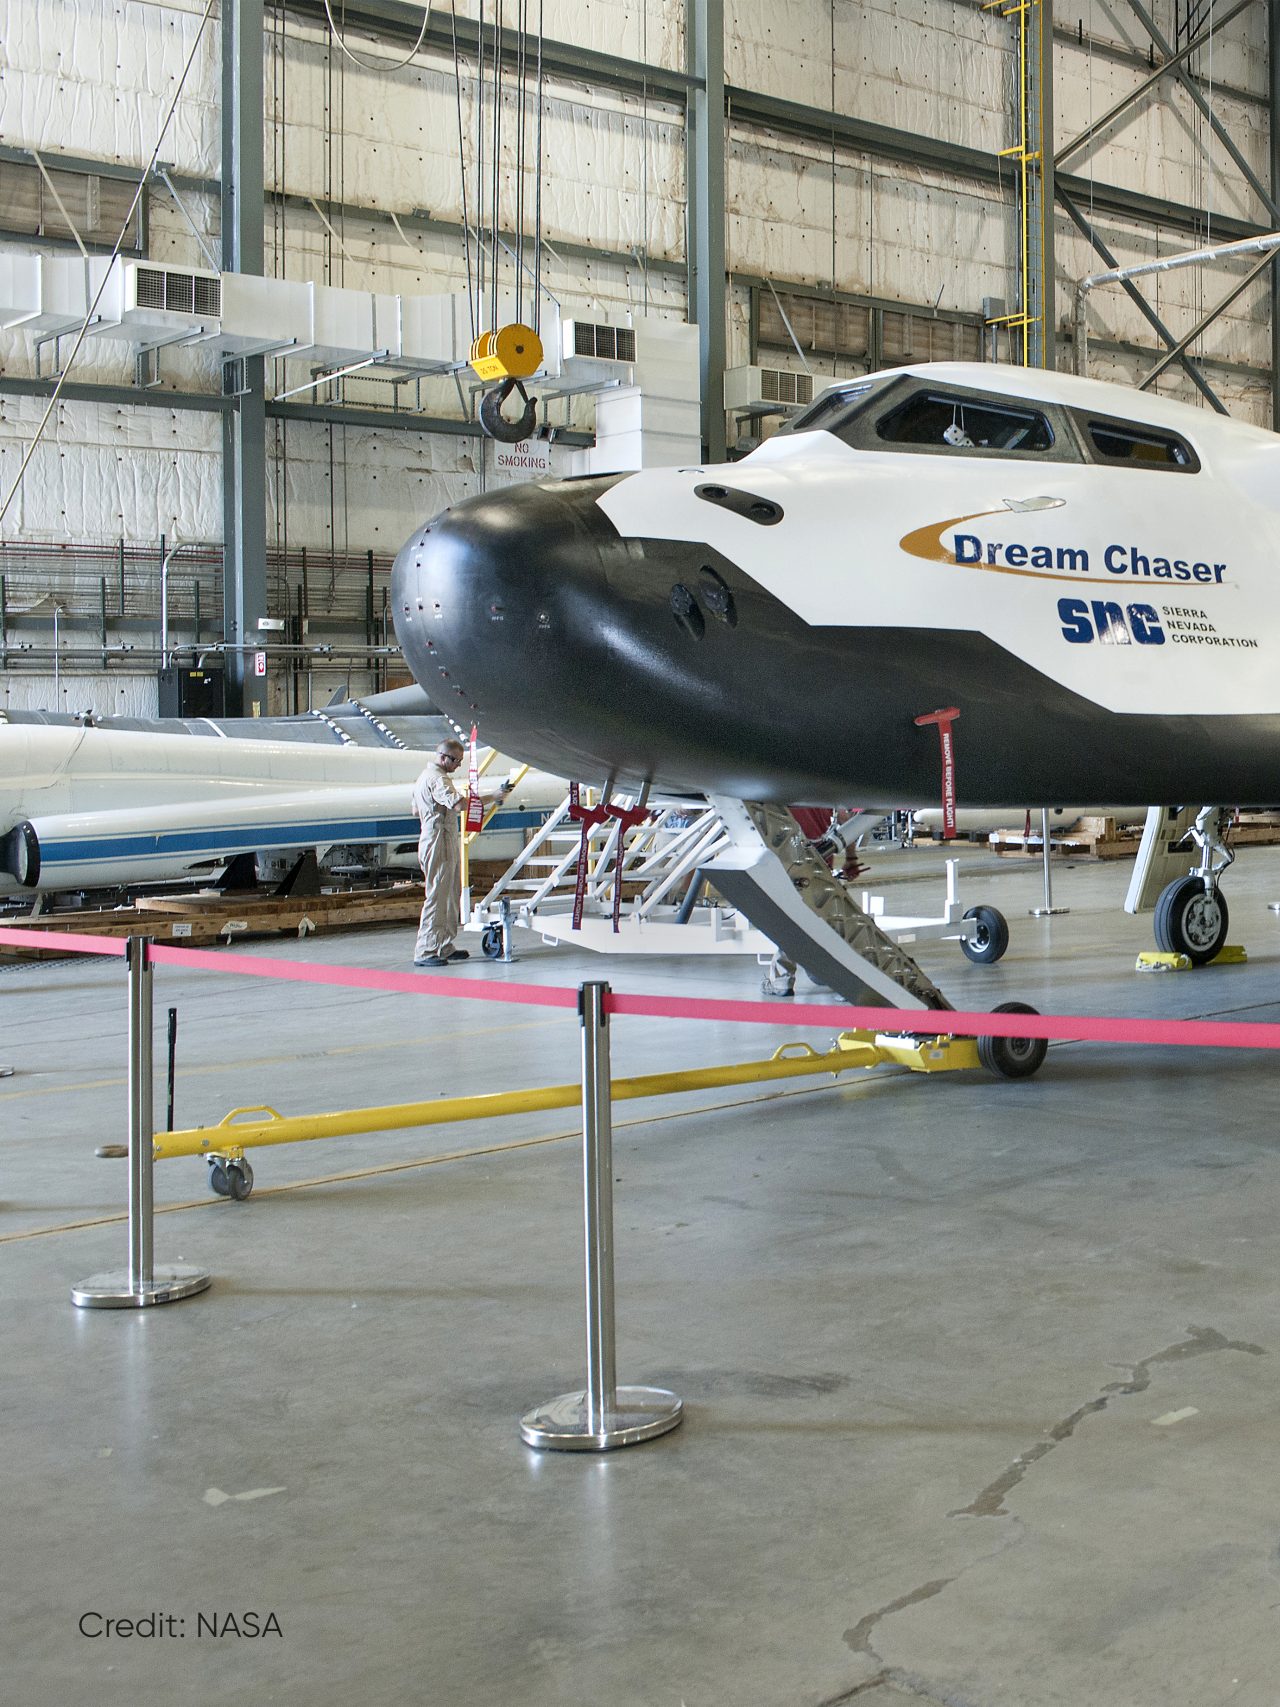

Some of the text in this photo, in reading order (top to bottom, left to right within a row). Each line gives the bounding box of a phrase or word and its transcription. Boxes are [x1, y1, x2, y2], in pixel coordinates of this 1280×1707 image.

[514, 442, 529, 454] NO
[497, 454, 546, 469] SMOKING
[953, 534, 1227, 583] Dream Chaser
[1162, 606, 1208, 619] SIERRA
[1167, 619, 1217, 633] NEVADA
[1172, 634, 1258, 648] CORPORATION
[943, 733, 952, 765] REMOVE
[581, 833, 589, 864] REMOVE
[577, 863, 586, 893] BEFORE
